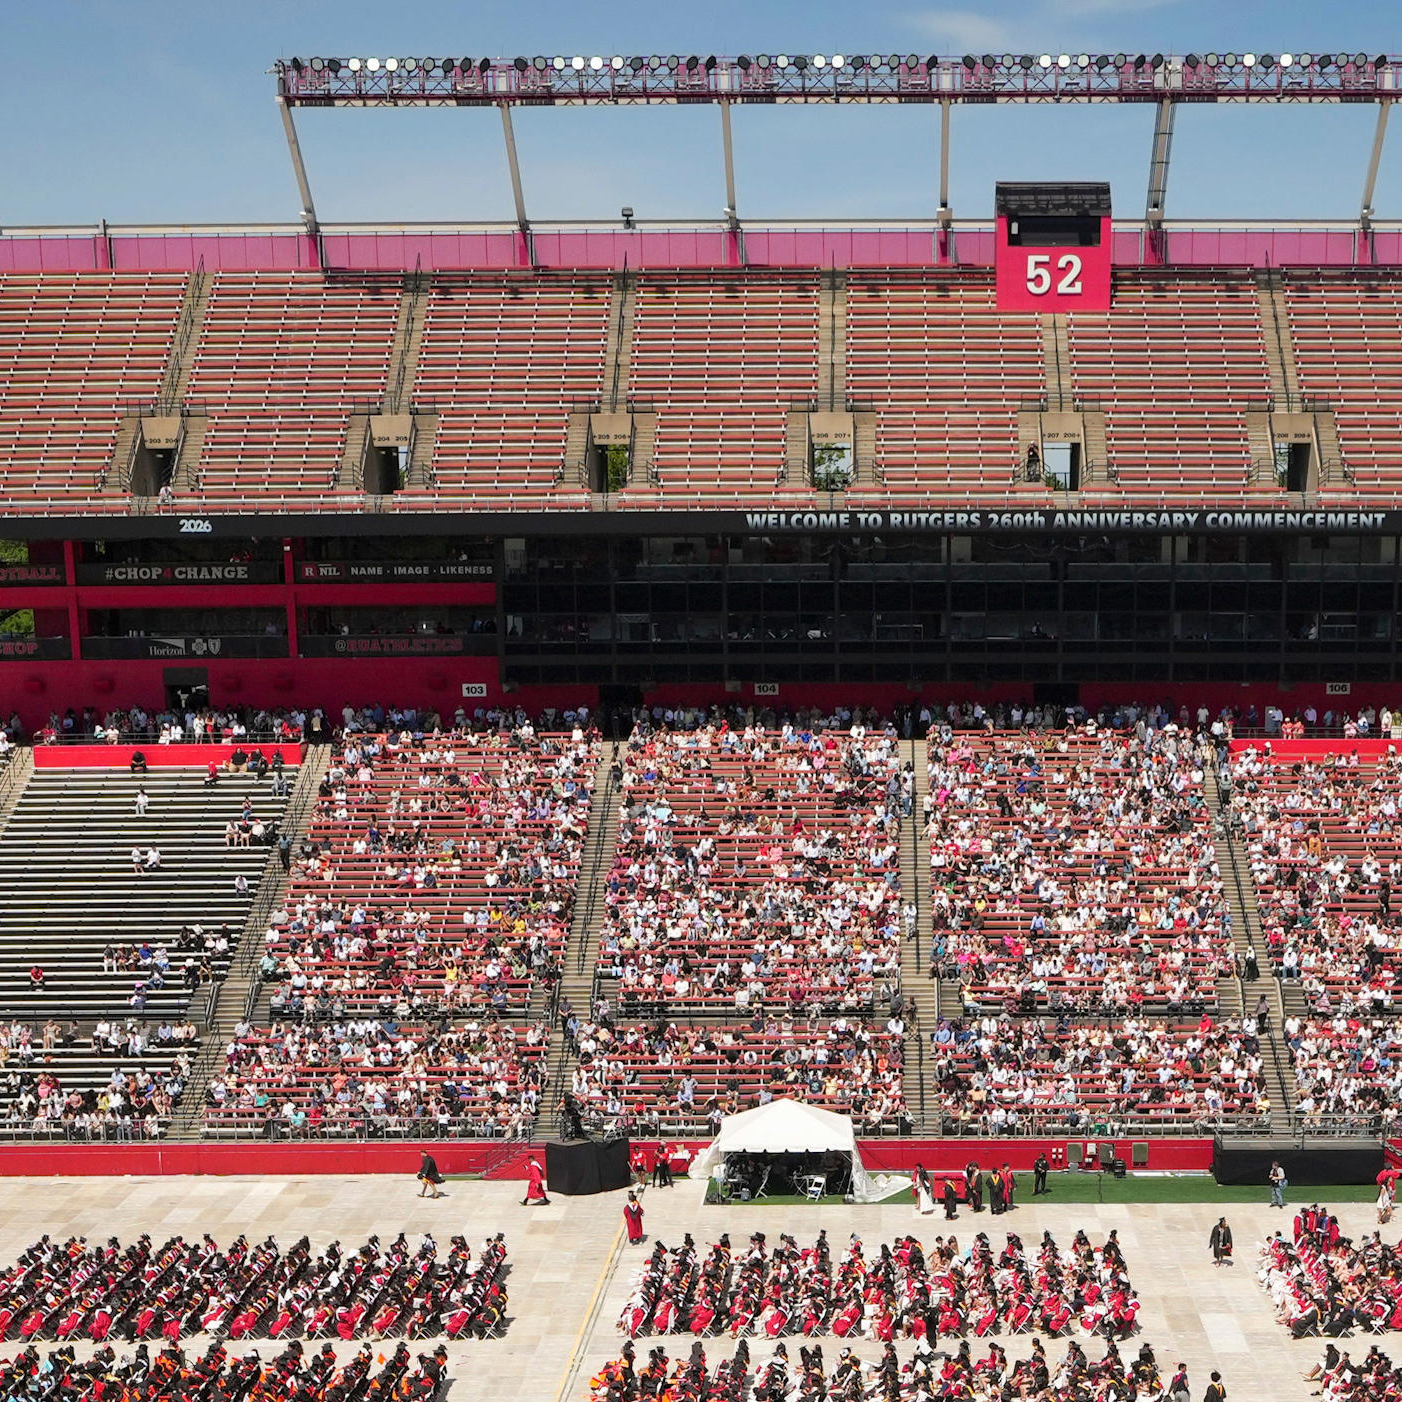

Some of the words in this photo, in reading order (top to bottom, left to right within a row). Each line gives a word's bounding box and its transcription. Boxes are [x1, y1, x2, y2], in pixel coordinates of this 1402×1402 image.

[1026, 254, 1083, 295] 52
[179, 518, 212, 533] 2026
[746, 513, 850, 530] WELCOME
[857, 513, 883, 530] TO
[889, 513, 981, 530] RUTGERS
[988, 512, 1046, 530] 260th
[1053, 513, 1199, 530] ANNIVERSARY
[1205, 513, 1386, 530] COMMENCEMENT
[319, 567, 340, 576] NIL
[350, 566, 383, 575] NAME
[394, 566, 429, 575] IMAGE
[440, 566, 493, 574] LIKENESS
[149, 646, 186, 656] Horizon
[465, 686, 484, 695] 103
[757, 684, 776, 693] 104
[1329, 684, 1347, 692] 106
